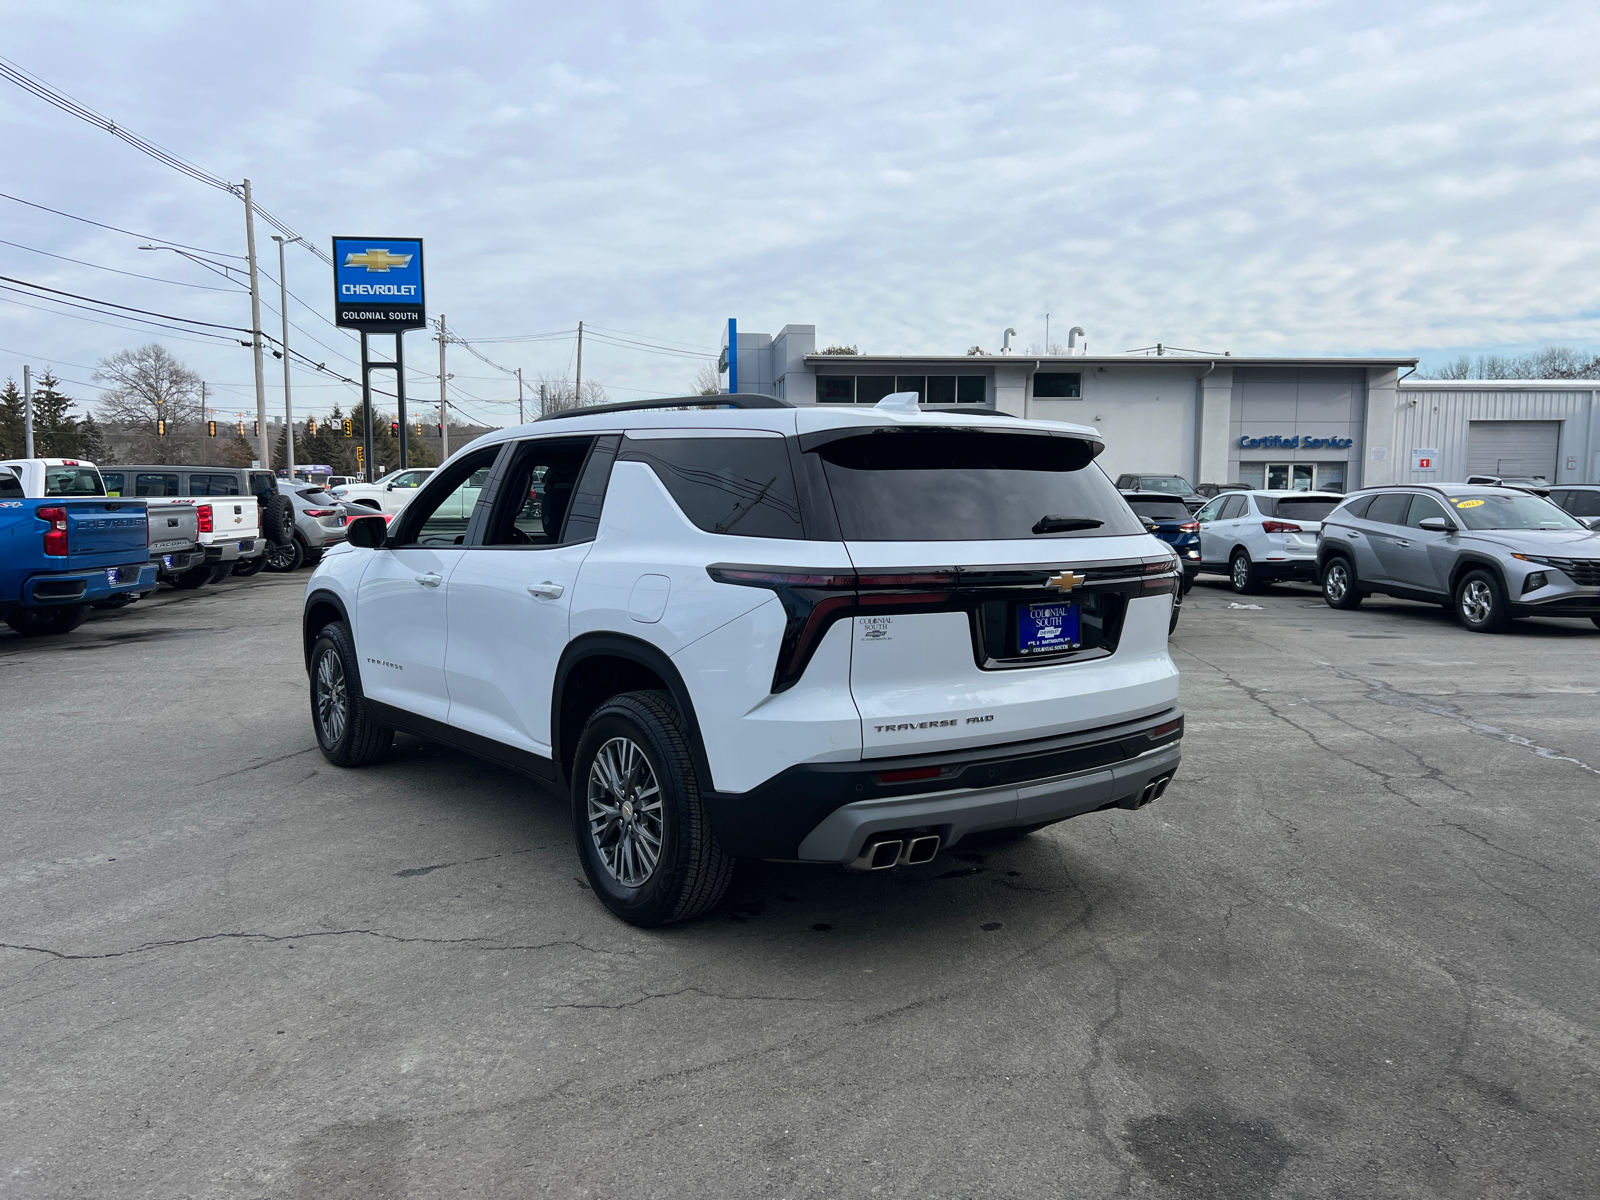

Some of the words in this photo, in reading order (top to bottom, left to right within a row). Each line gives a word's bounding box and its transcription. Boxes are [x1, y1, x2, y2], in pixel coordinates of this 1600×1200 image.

[342, 284, 417, 295] CHEVROLET
[342, 311, 386, 320] COLONIAL
[388, 312, 418, 320] SOUTH
[1240, 435, 1299, 448] Certified
[1303, 436, 1353, 448] Service
[1461, 500, 1480, 508] 2023
[153, 540, 187, 548] TACOMA
[1030, 607, 1067, 619] COLONIAL
[859, 617, 893, 625] COLONIAL
[1035, 616, 1062, 628] SOUTH
[864, 623, 888, 631] SOUTH
[873, 719, 959, 733] TRAVERSE
[966, 715, 995, 725] AWD
